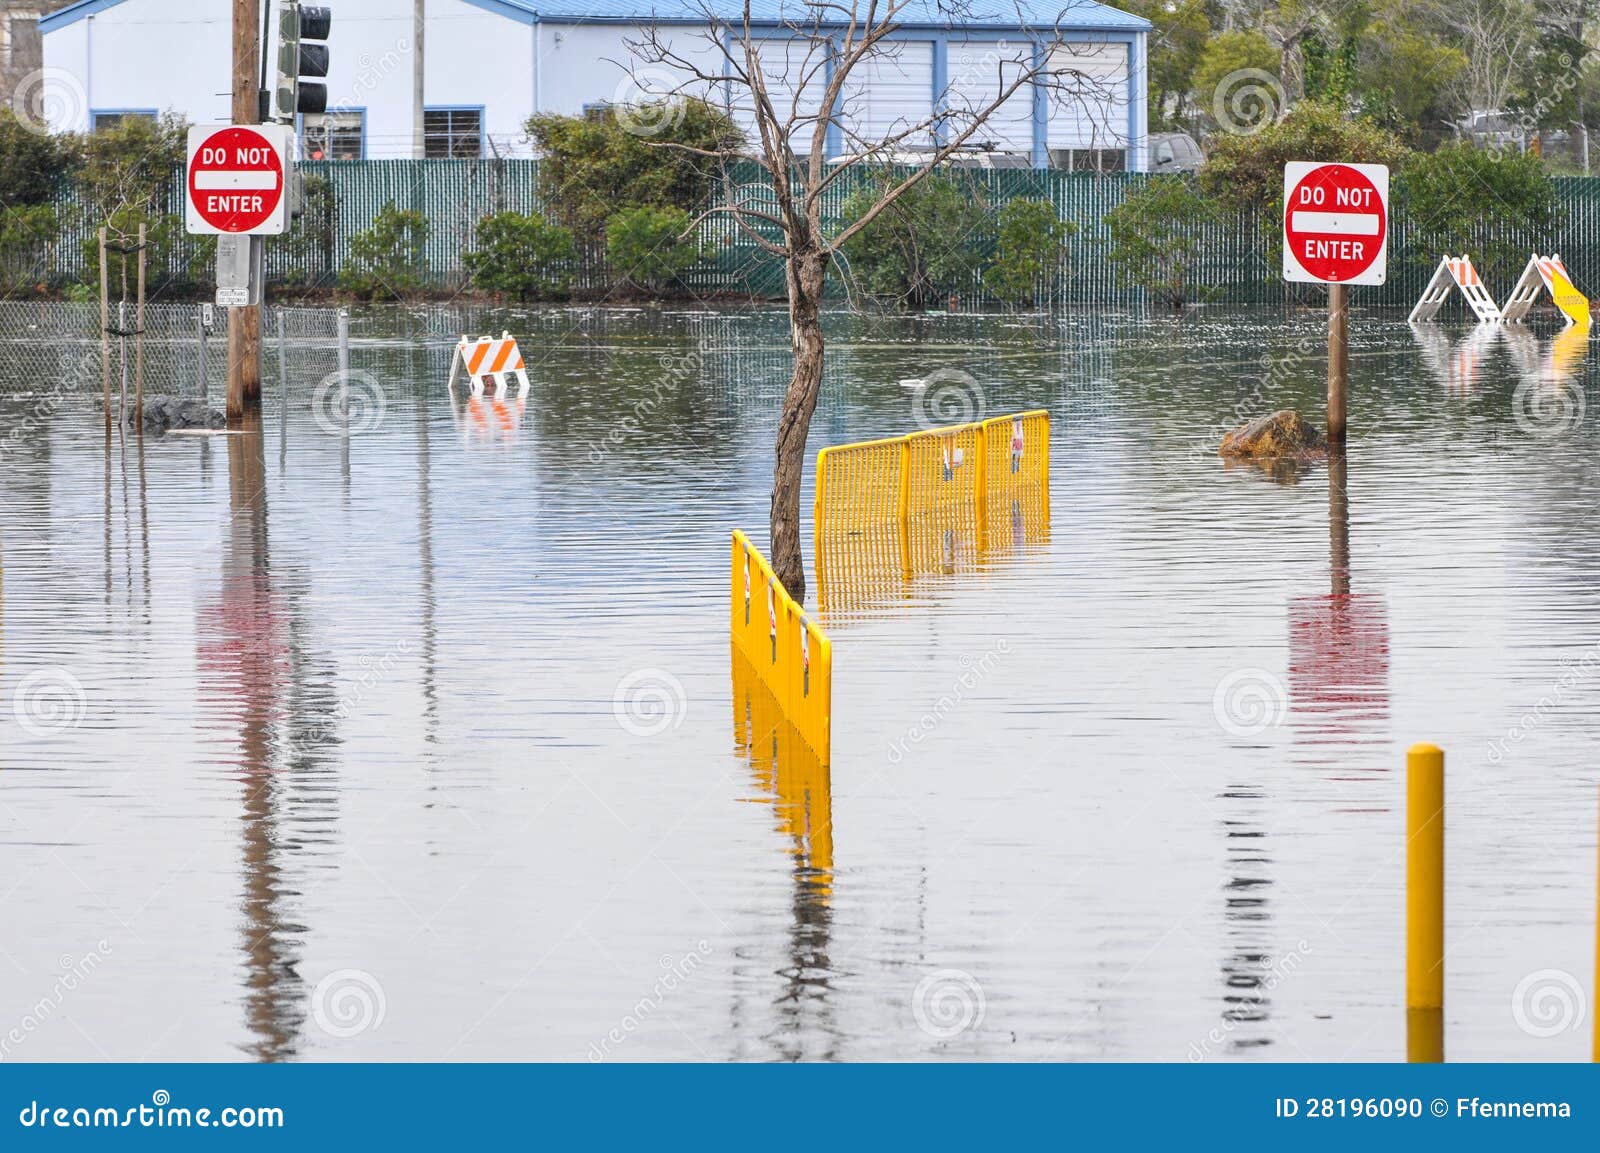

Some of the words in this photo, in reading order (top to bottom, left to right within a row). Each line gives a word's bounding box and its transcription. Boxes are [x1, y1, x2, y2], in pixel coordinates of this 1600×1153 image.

[202, 147, 226, 165] DO
[236, 147, 271, 165] NOT
[207, 195, 263, 213] ENTER
[1300, 186, 1325, 205] DO
[1336, 187, 1373, 207] NOT
[1305, 240, 1364, 261] ENTER
